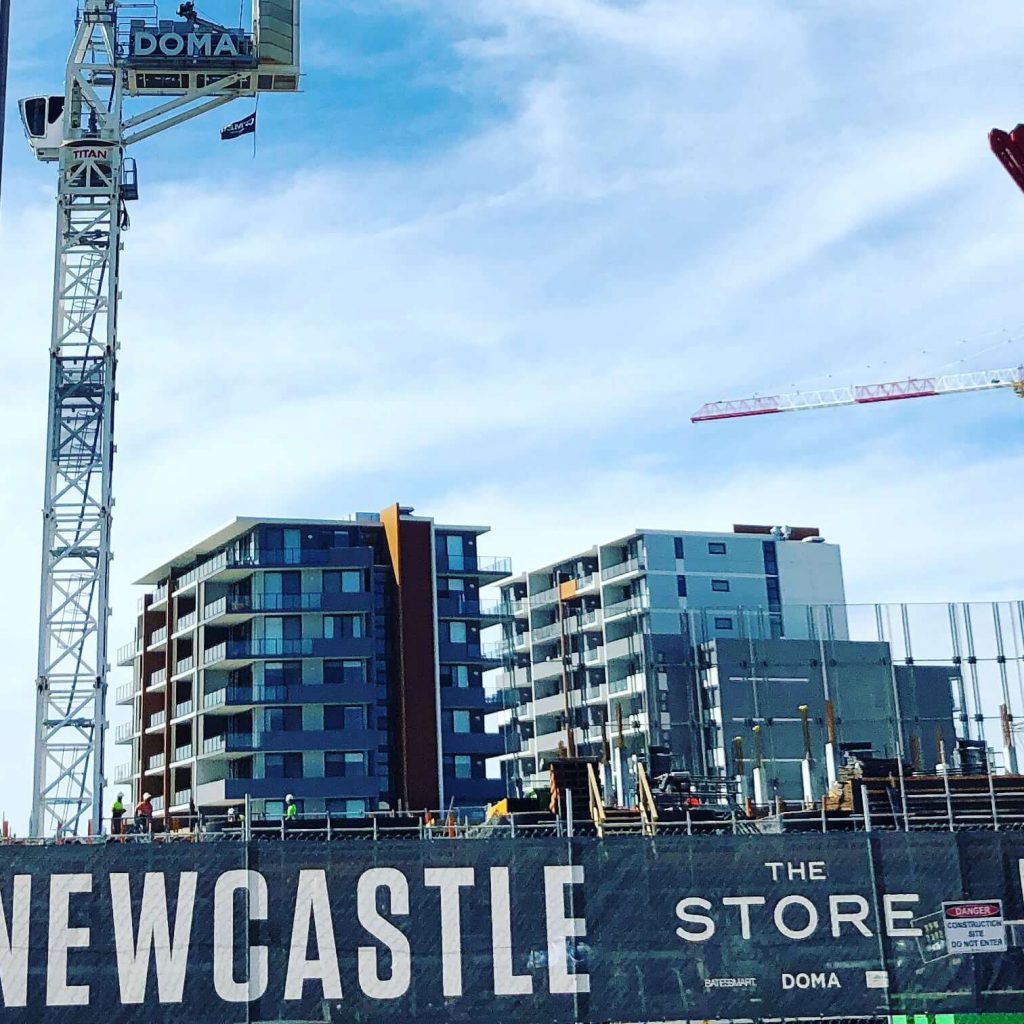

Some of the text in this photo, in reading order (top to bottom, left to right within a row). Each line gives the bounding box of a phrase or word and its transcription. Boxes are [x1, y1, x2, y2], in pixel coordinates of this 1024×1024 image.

[134, 32, 239, 56] DOMA
[73, 149, 107, 159] TITAN
[765, 861, 826, 881] THE
[676, 893, 923, 942] STORE
[955, 906, 991, 916] DANGER
[947, 920, 1002, 929] CONSTRUCTION
[979, 938, 1003, 946] ENTER
[781, 972, 842, 990] DOMA
